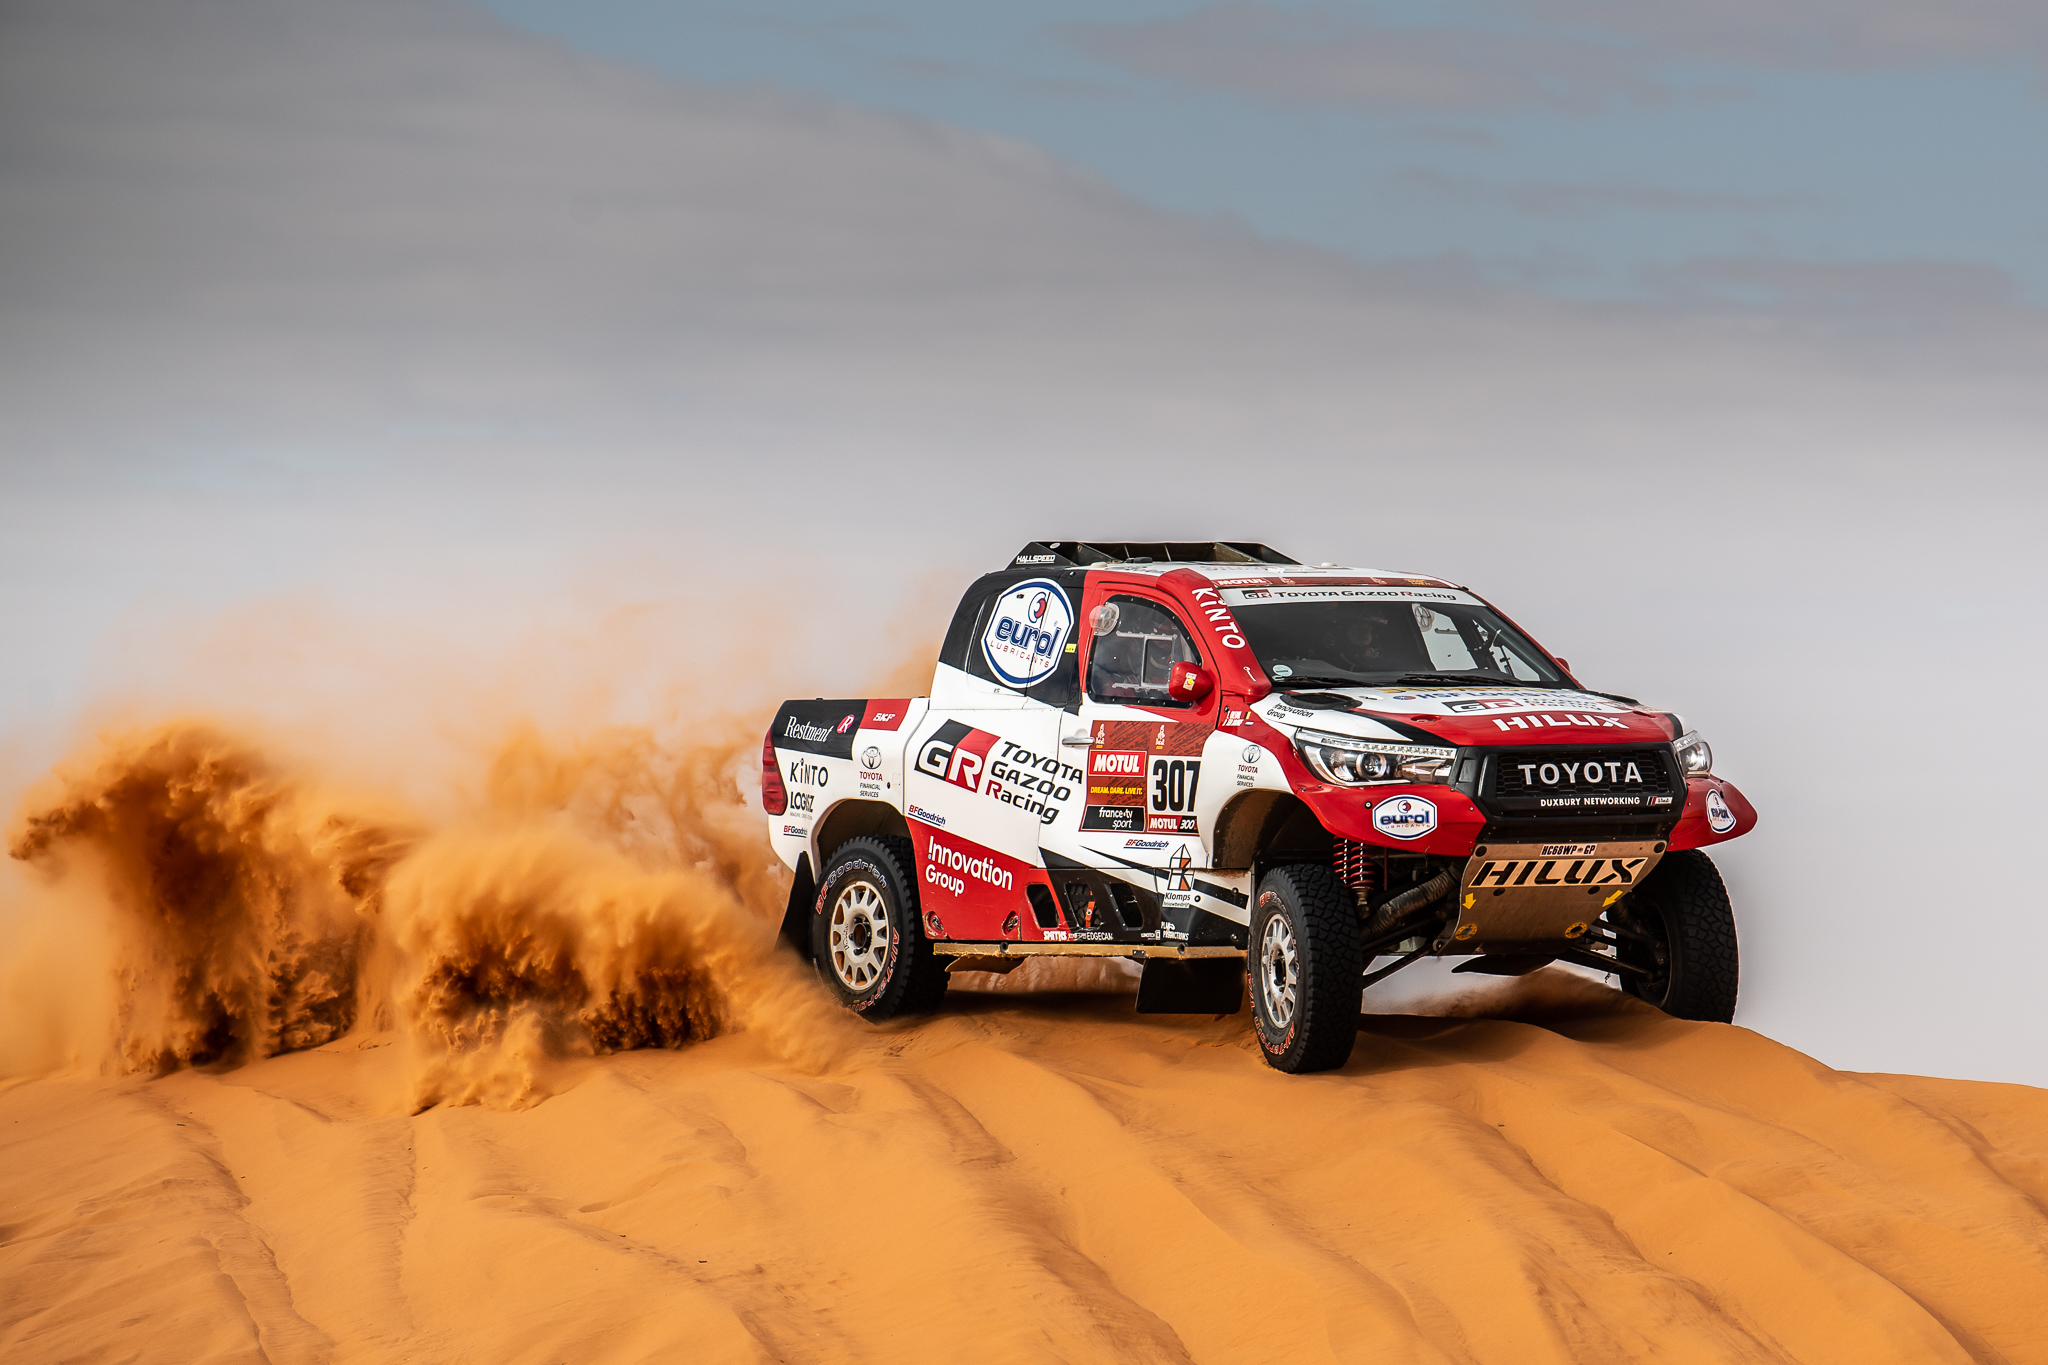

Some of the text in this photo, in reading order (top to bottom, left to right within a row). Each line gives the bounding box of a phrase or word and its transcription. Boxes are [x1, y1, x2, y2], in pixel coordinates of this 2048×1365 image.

[1016, 555, 1056, 563] HALLSPEED
[1243, 590, 1272, 599] GR
[1400, 590, 1457, 600] Racing
[995, 616, 1062, 659] eurol
[990, 640, 1050, 668] LUBRICANTS
[1267, 708, 1286, 719] Group
[1274, 703, 1314, 718] Innovation
[1445, 700, 1522, 713] GR
[873, 712, 896, 722] SKF
[1492, 714, 1630, 732] HILUX
[784, 715, 834, 742] Restment
[915, 737, 988, 792] GR
[1000, 741, 1083, 784] TOYOTA
[1093, 754, 1140, 773] MOTUL
[1238, 764, 1258, 774] TOYOTA
[860, 771, 883, 781] TOYOTA
[1518, 761, 1643, 785] TOYOTA
[860, 782, 881, 790] FINANCIAL
[991, 761, 1071, 802] GAZOO
[1152, 759, 1201, 812] 307
[1236, 780, 1254, 788] SERVICES
[860, 790, 879, 798] SERVICES
[1540, 796, 1640, 807] DUXBURY NETWORKING
[985, 779, 1060, 825] Racing
[908, 804, 946, 825] BFGoodrich
[1380, 810, 1430, 826] eurol
[1112, 819, 1133, 830] sport
[1149, 817, 1178, 830] MOTUL
[1125, 838, 1169, 848] BFGoodrich
[1541, 845, 1596, 856] HC68WP GP
[1471, 858, 1646, 886] HILUX
[815, 858, 888, 914] BFGoodrich
[925, 864, 965, 897] Group
[1164, 892, 1191, 901] Klomps
